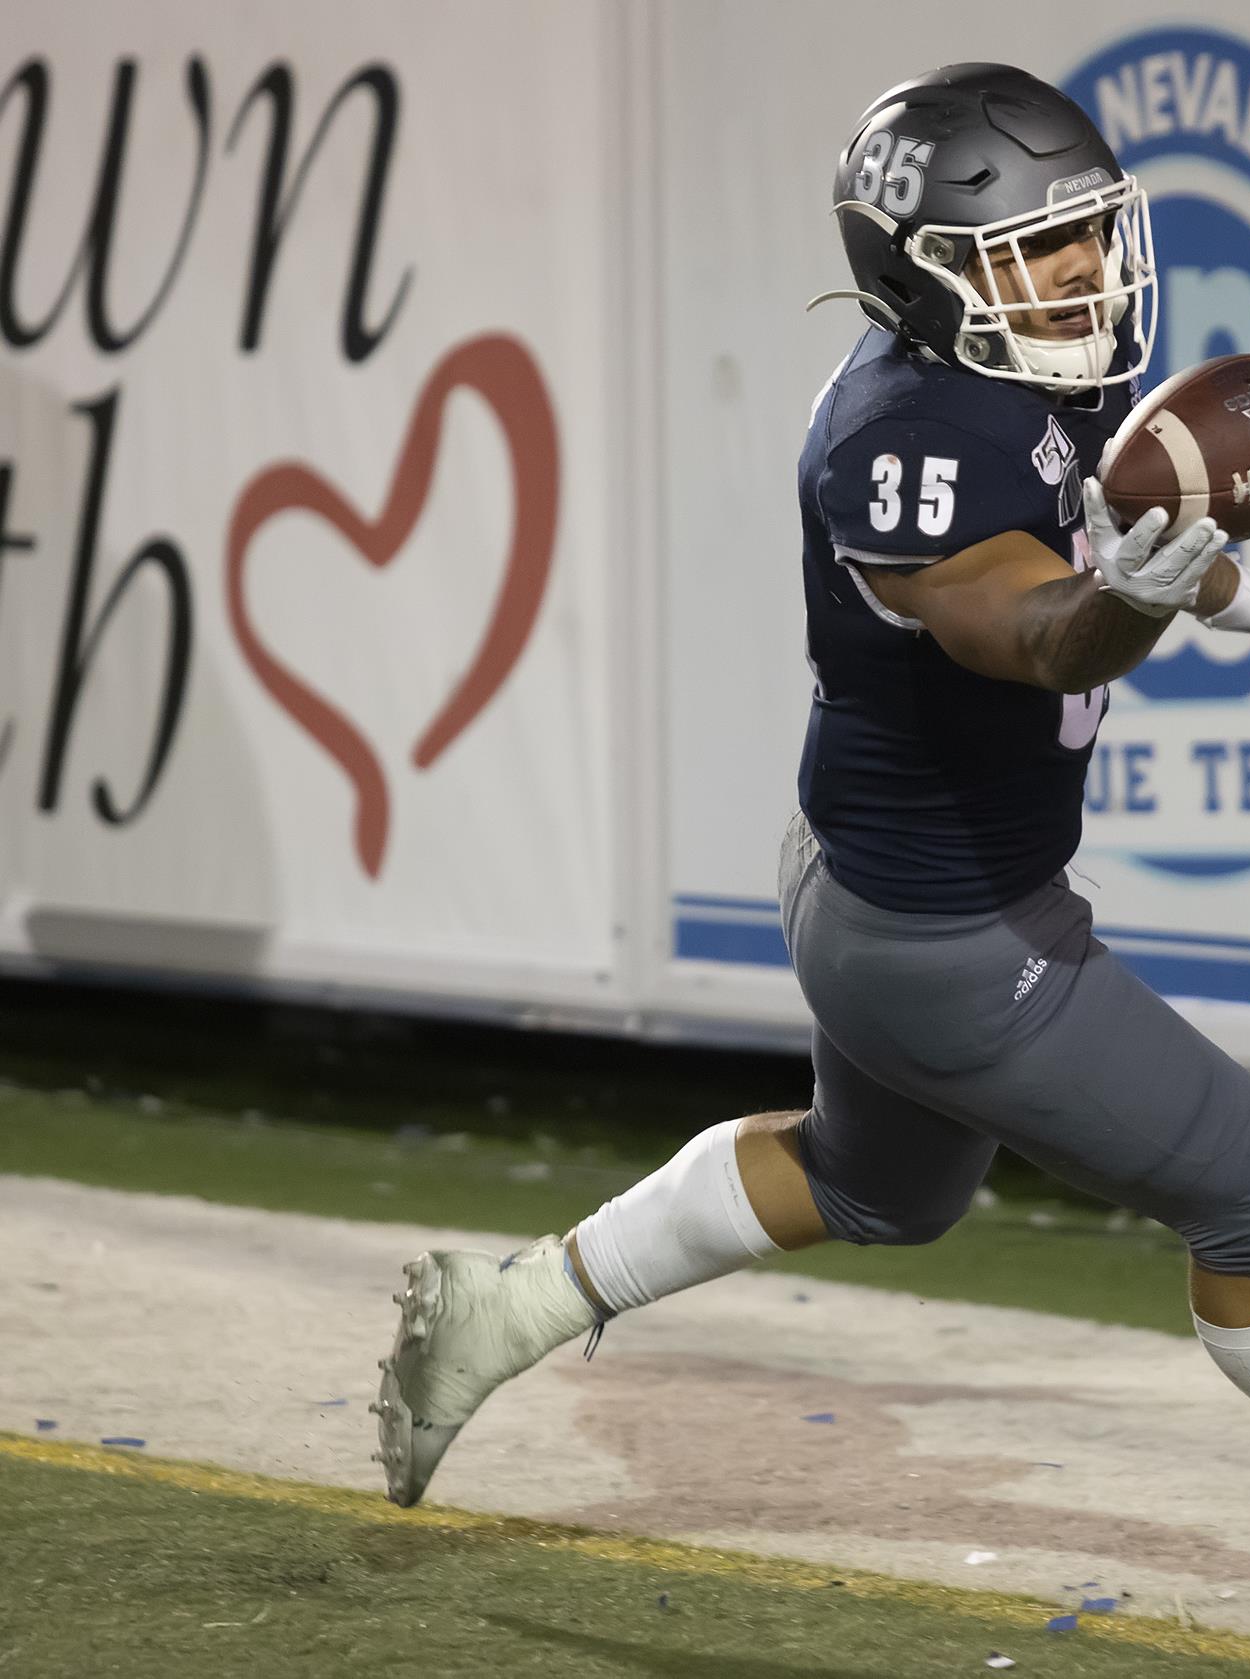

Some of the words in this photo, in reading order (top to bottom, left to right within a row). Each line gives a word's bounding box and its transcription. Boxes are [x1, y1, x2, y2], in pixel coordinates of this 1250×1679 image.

[853, 128, 937, 219] 35
[1064, 172, 1103, 194] NEVADA
[868, 453, 959, 537] 35
[1014, 958, 1048, 1000] adidas
